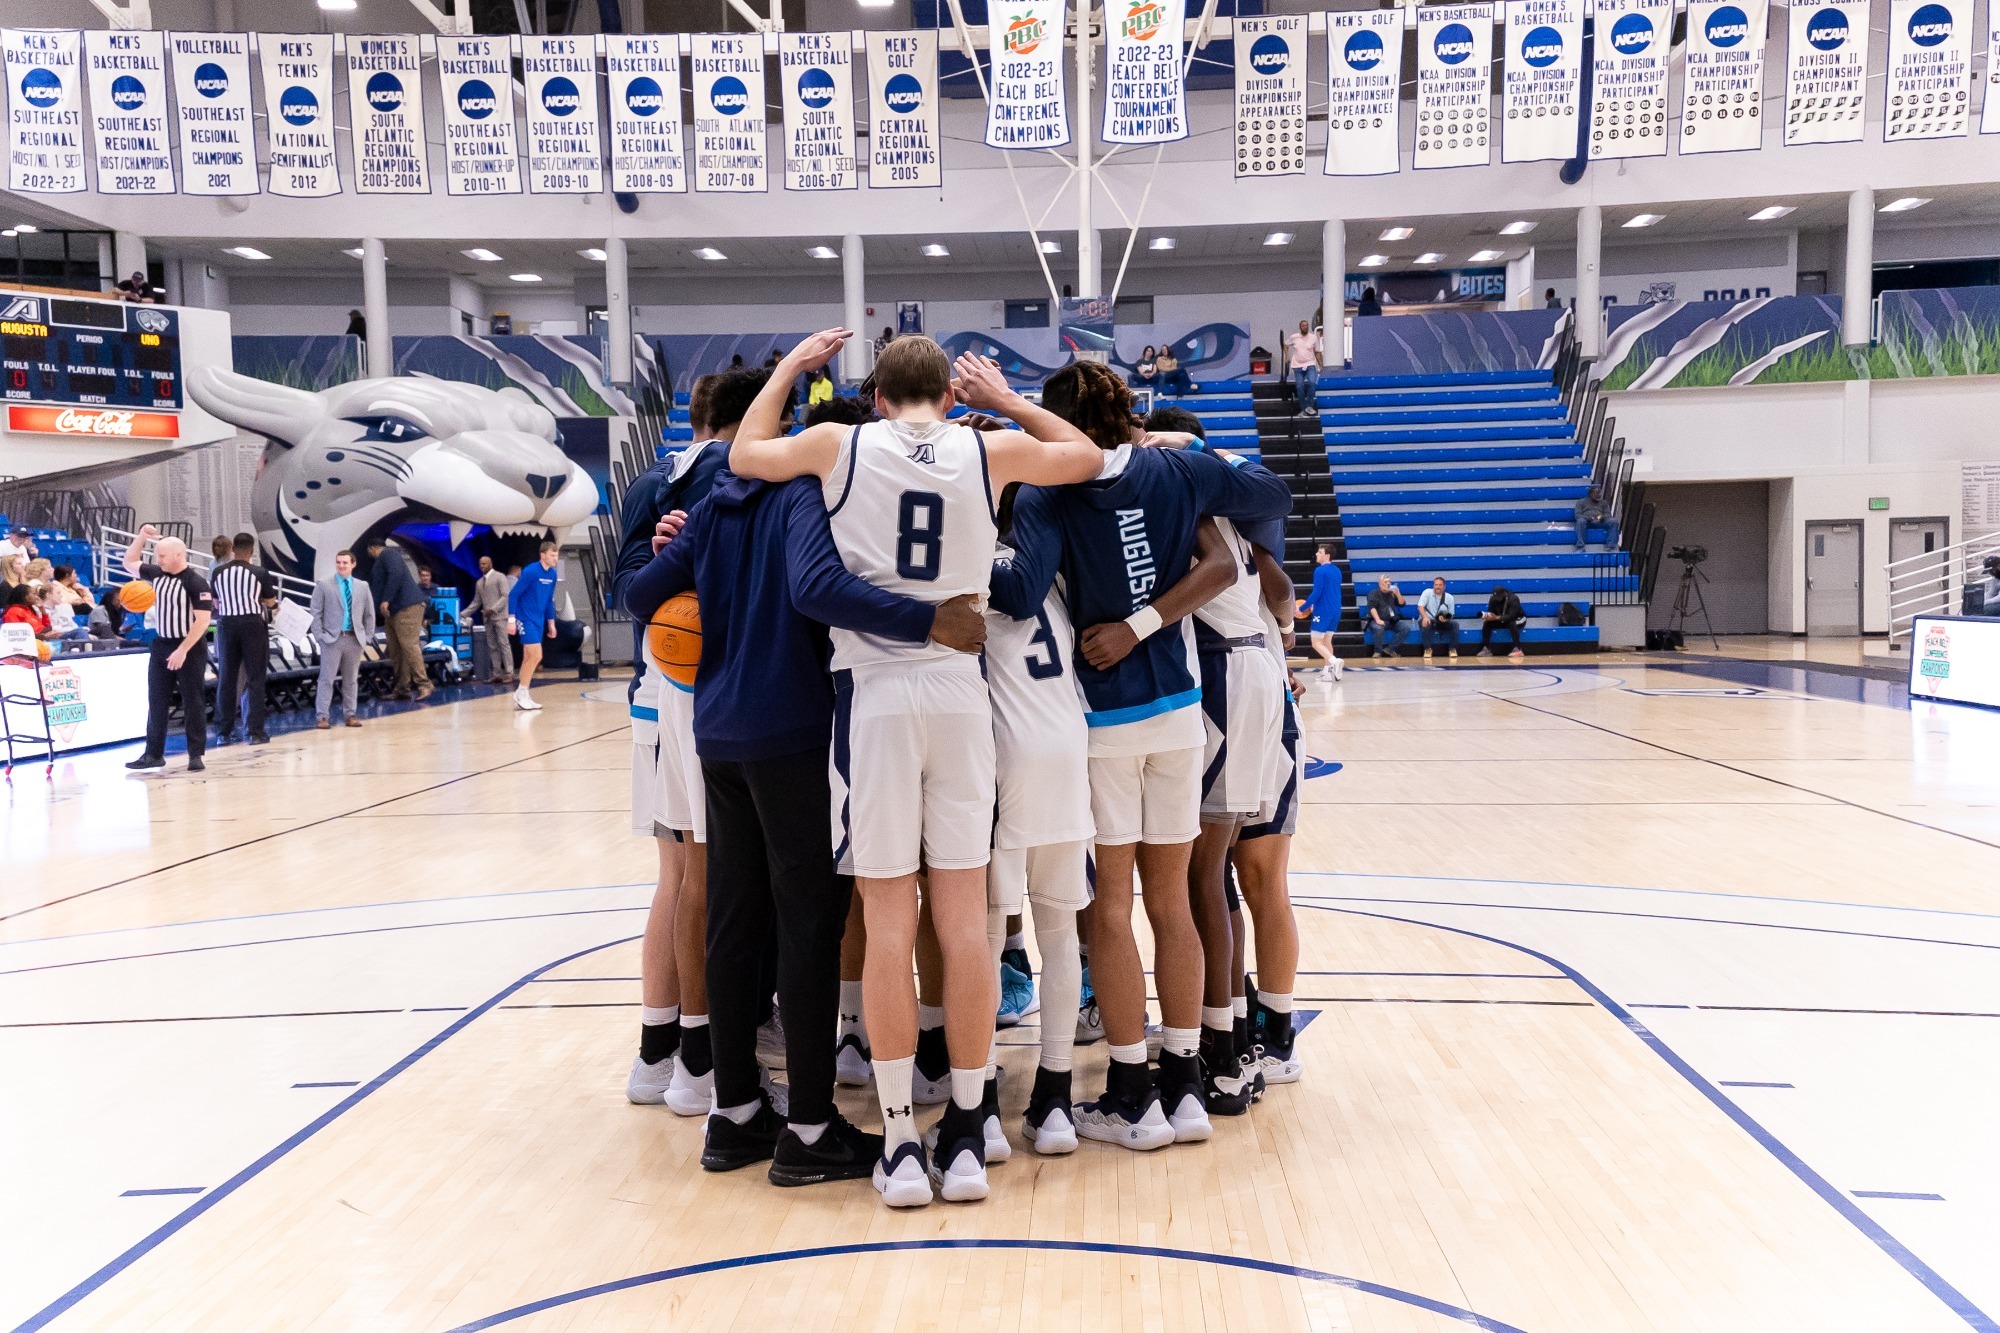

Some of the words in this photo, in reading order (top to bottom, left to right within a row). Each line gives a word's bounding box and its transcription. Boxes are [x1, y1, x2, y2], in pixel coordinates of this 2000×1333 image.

[1525, 1, 1566, 12] WOMEN'S
[1598, 0, 1625, 11] MEN'S
[1122, 6, 1165, 37] PBC
[1336, 15, 1362, 26] MEN'S
[1372, 14, 1394, 25] GOLF
[1420, 10, 1441, 21] MEN'S
[1444, 8, 1491, 20] BASKETBALL
[1515, 12, 1574, 25] BASKETBALL
[1241, 20, 1267, 32] MEN'S
[1277, 19, 1299, 31] GOLF
[1709, 24, 1748, 38] NCAA
[1911, 24, 1952, 37] NCAA
[23, 35, 58, 49] MEN'S
[110, 36, 140, 49] MEN'S
[799, 35, 831, 49] MEN'S
[1004, 20, 1047, 51] PBC
[1810, 30, 1849, 42] NCAA
[176, 40, 242, 54] VOLLEYBALL
[281, 43, 312, 56] MEN'S
[361, 41, 407, 54] WOMEN'S
[542, 40, 575, 54] MEN'S
[712, 40, 743, 54] MEN'S
[885, 38, 917, 52] MEN'S
[1438, 43, 1473, 55] NCAA
[1525, 46, 1562, 58] NCAA
[7, 50, 75, 65] BASKETBALL
[784, 51, 848, 66] BASKETBALL
[1119, 45, 1173, 61] 2022-23
[1254, 54, 1289, 66] NCAA
[1348, 49, 1383, 62] NCAA
[1688, 53, 1708, 64] NCAA
[1716, 51, 1749, 62] DIVISION
[1799, 54, 1840, 67] DIVISION
[1850, 53, 1857, 64] II
[1903, 52, 1944, 64] DIVISION
[1951, 50, 1958, 62] II
[94, 56, 159, 70] BASKETBALL
[351, 56, 417, 70] BASKETBALL
[527, 58, 592, 72] BASKETBALL
[696, 58, 760, 72] BASKETBALL
[889, 54, 915, 67] GOLF
[278, 64, 318, 78] TENNIS
[1002, 61, 1052, 78] 2022-23
[1420, 69, 1438, 80] NCAA
[1446, 67, 1476, 79] DIVISION
[1483, 66, 1488, 77] II
[1507, 72, 1526, 82] NCAA
[1534, 70, 1565, 81] DIVISION
[1572, 68, 1577, 78] II
[1691, 63, 1758, 78] CHAMPIONSHIP
[1793, 67, 1862, 81] CHAMPIONSHIP
[1895, 63, 1964, 78] CHAMPIONSHIP
[197, 80, 228, 90] NCAA
[1112, 79, 1178, 98] CONFERENCE
[1247, 79, 1283, 90] DIVISION
[1292, 79, 1295, 89] I
[1332, 77, 1350, 88] NCAA
[1356, 75, 1388, 87] DIVISION
[1423, 80, 1485, 94] CHAMPIONSHIP
[1510, 81, 1574, 94] CHAMPIONSHIP
[1695, 78, 1754, 91] PARTICIPANT
[1796, 80, 1858, 94] PARTICIPANT
[1899, 77, 1960, 91] PARTICIPANT
[25, 87, 63, 98] NCAA
[115, 92, 146, 102] NCAA
[370, 91, 404, 102] NCAA
[801, 87, 834, 99] NCAA
[888, 93, 922, 104] NCAA
[1241, 91, 1301, 104] CHAMPIONSHIP
[1333, 89, 1394, 102] CHAMPIONSHIP
[546, 96, 579, 107] NCAA
[714, 95, 748, 106] NCAA
[1426, 94, 1481, 107] PARTICIPANT
[1513, 94, 1570, 106] PARTICIPANT
[182, 107, 244, 121] SOUTHEAST
[283, 105, 319, 116] NCAA
[995, 102, 1060, 121] CONFERENCE
[1115, 98, 1176, 118] TOURNAMENT
[1241, 105, 1301, 118] APPEARANCES
[1334, 103, 1393, 116] APPEARANCES
[98, 117, 161, 131] SOUTHEAST
[372, 114, 404, 127] SOUTH
[803, 111, 834, 125] SOUTH
[533, 122, 594, 135] SOUTHEAST
[696, 119, 719, 133] SOUTH
[729, 119, 763, 133] ATLANTIC
[880, 119, 928, 133] CENTRAL
[1113, 117, 1179, 136] CHAMPIONS
[21, 132, 77, 147] REGIONAL
[191, 130, 240, 143] REGIONAL
[365, 129, 414, 143] ATLANTIC
[795, 126, 842, 141] ATLANTIC
[995, 124, 1060, 143] CHAMPIONS
[106, 137, 159, 150] REGIONAL
[539, 139, 591, 153] REGIONAL
[705, 137, 756, 151] REGIONAL
[795, 142, 844, 157] REGIONAL
[880, 136, 930, 149] REGIONAL
[365, 144, 415, 158] REGIONAL
[875, 151, 935, 165] CHAMPIONS
[193, 152, 243, 165] CHAMPIONS
[271, 152, 334, 168] SEMIFINALIST
[362, 159, 420, 172] CHAMPIONS
[532, 157, 599, 171] HOST/CHAMPIONS
[699, 155, 763, 169] HOST/CHAMPIONS
[836, 158, 854, 171] SEED
[208, 174, 231, 187] 2021
[362, 174, 421, 187] 2003-2004
[708, 173, 754, 186] 2007-08
[799, 174, 843, 187] 2006-07
[892, 167, 918, 180] 2005
[23, 174, 75, 189] 2022-23
[116, 177, 156, 189] 2021-22
[292, 176, 317, 189] 2012
[543, 175, 588, 188] 2009-10
[1460, 275, 1504, 295] BITES
[1, 322, 47, 336] AUGUSTA
[77, 335, 103, 343] PERIOD
[4, 361, 29, 369] FOULS
[68, 366, 95, 375] PLAYER
[98, 367, 116, 376] FOUL
[152, 372, 174, 380] FOULS
[14, 371, 25, 387] 0
[161, 381, 170, 396] 0
[6, 391, 30, 399] SCORE
[80, 395, 106, 403] MATCH
[896, 489, 945, 582] 8
